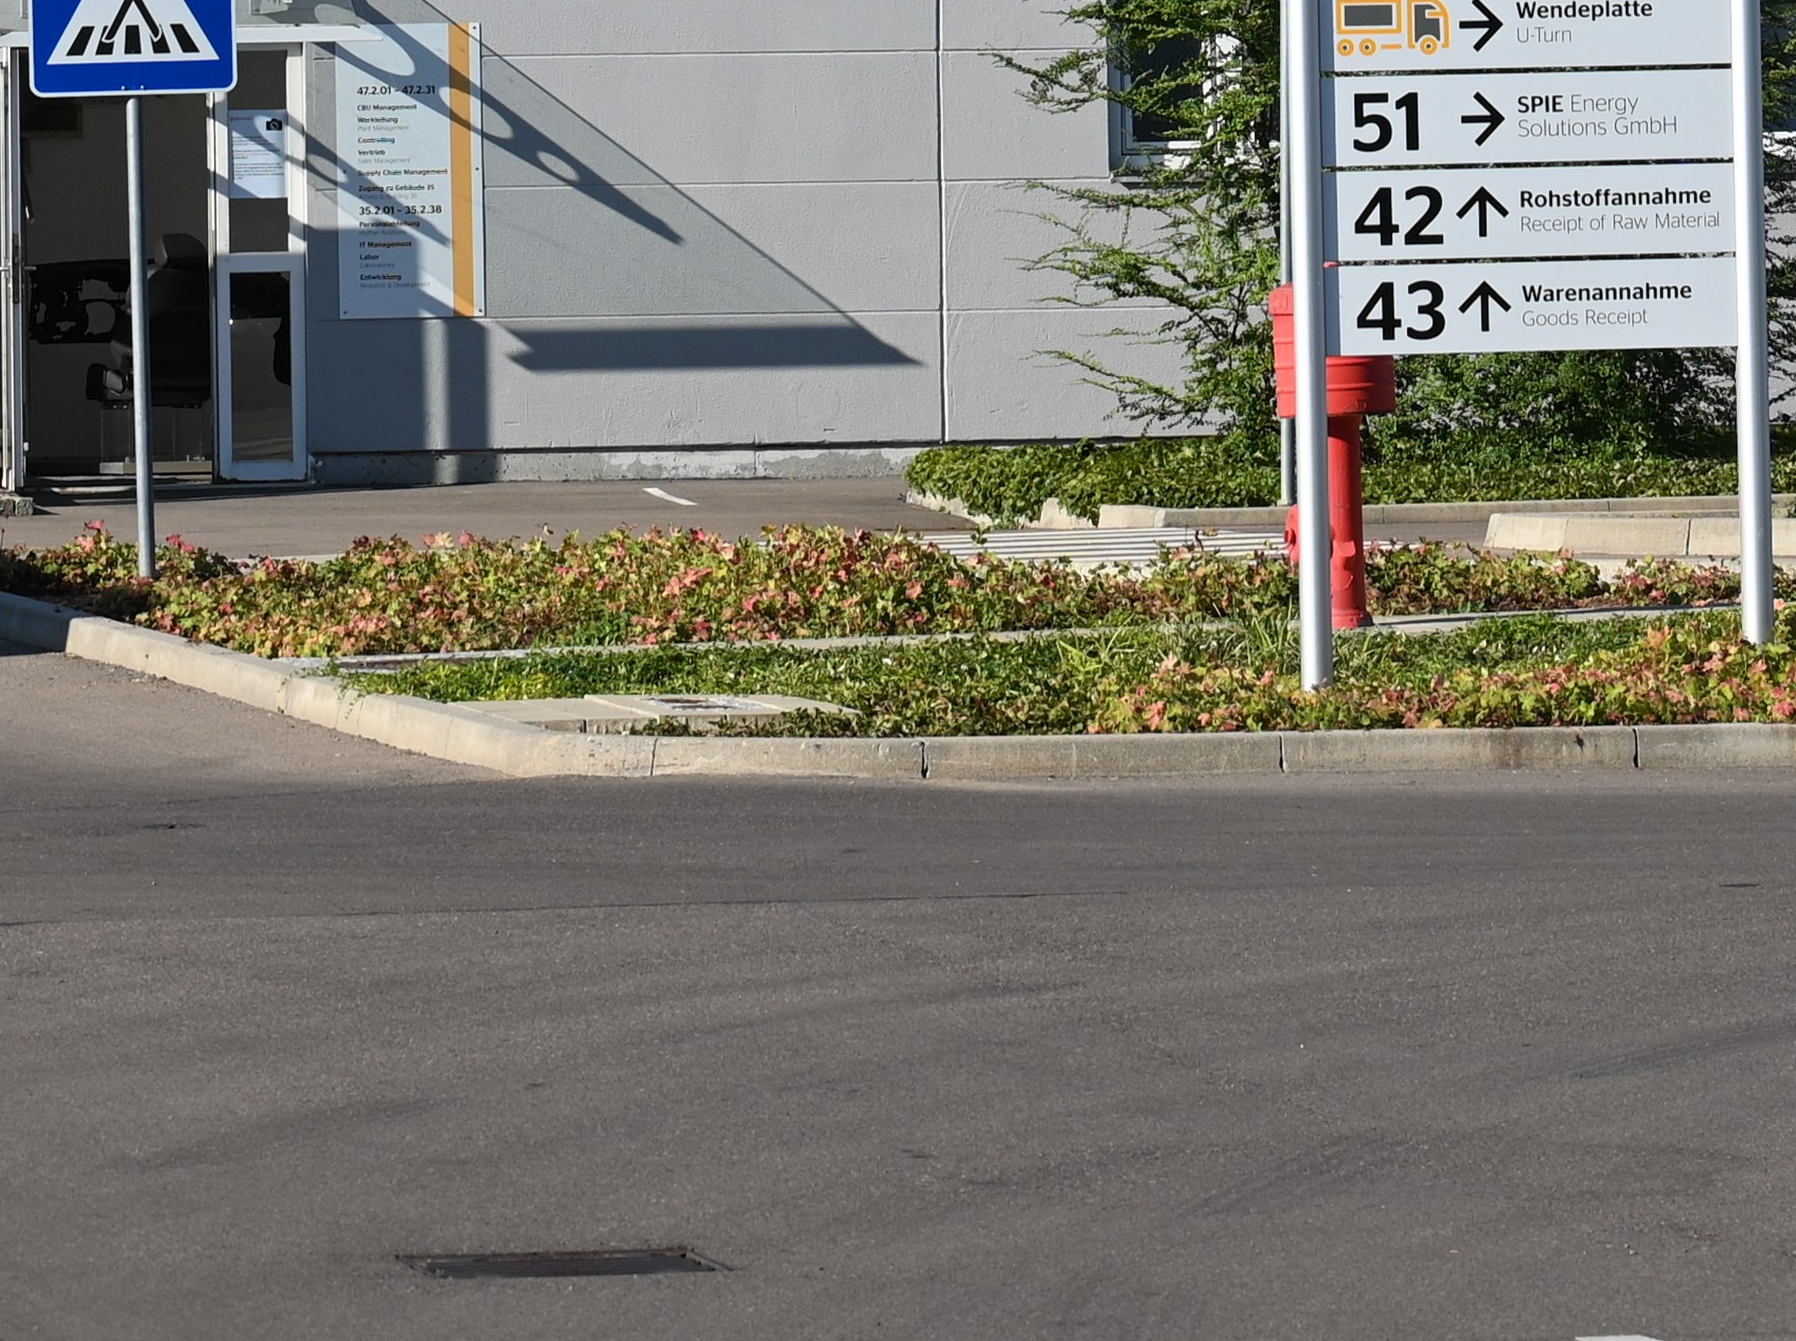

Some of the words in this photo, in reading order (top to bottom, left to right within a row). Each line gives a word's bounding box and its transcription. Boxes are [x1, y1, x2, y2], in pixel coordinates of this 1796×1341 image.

[1515, 0, 1654, 22] Wendeplatte
[1516, 27, 1572, 43] U-Turn
[1353, 91, 1420, 152] 51
[1518, 95, 1564, 113] SPIE
[1570, 94, 1639, 115] Energy
[1518, 117, 1607, 138] Solutions
[1614, 116, 1678, 135] GmbH
[1354, 185, 1444, 246] 42
[1519, 188, 1711, 208] Rohstoffannahme
[1520, 216, 1583, 234] Receipt
[1589, 214, 1605, 231] of
[1612, 214, 1650, 231] Raw
[1655, 211, 1720, 230] Material
[1356, 280, 1445, 340] 43
[1522, 283, 1692, 302] Warenannahme
[1522, 309, 1578, 326] Goods
[1585, 308, 1649, 326] Receipt
